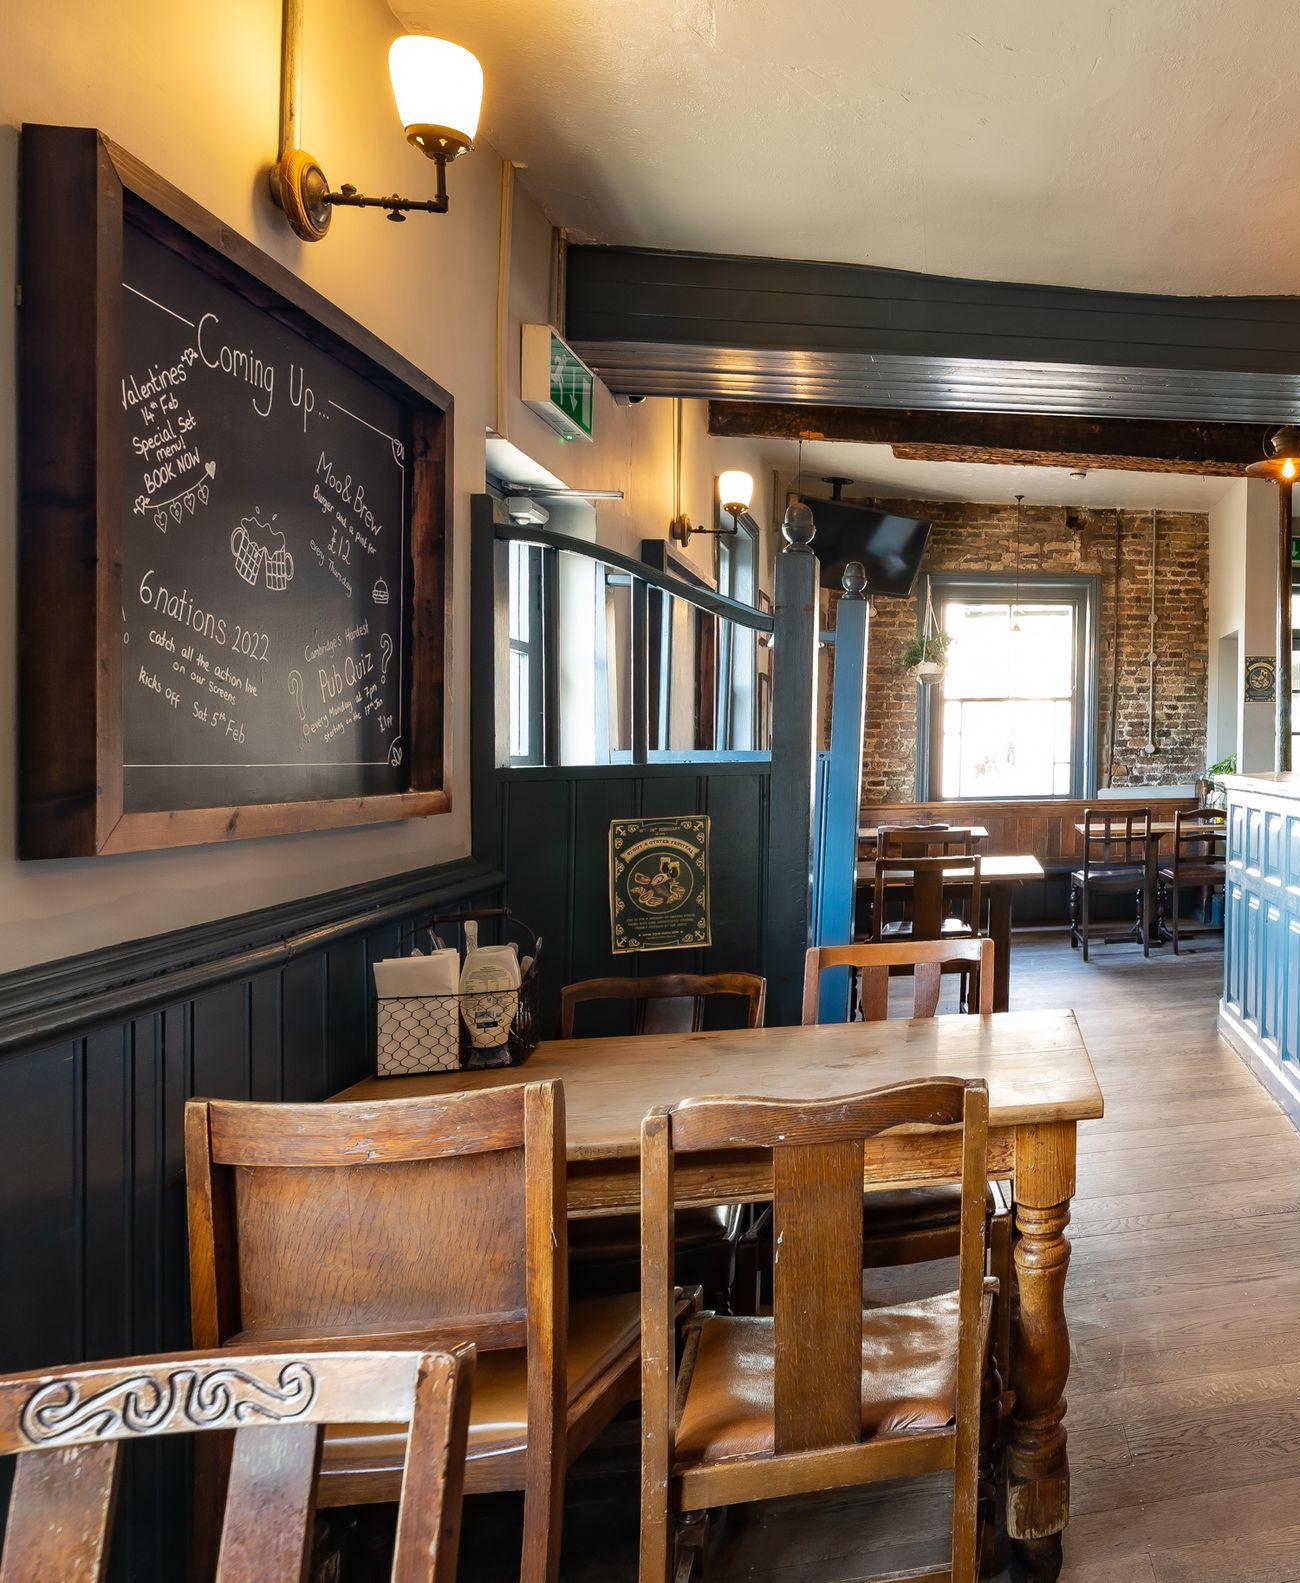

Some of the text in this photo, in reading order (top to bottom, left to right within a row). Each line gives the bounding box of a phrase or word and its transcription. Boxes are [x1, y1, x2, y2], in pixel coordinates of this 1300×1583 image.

[121, 363, 187, 411] Valentines
[198, 312, 274, 417] Coming
[160, 392, 179, 415] Feb
[132, 409, 197, 461] Special Set
[143, 446, 201, 494] BOOK NOW
[313, 484, 334, 514] Burger
[342, 475, 351, 503] &
[354, 485, 382, 536] Brew
[328, 526, 351, 566] £12
[139, 570, 269, 663] 6 nations 2022
[172, 660, 237, 706] on our screens
[181, 645, 194, 662] all
[196, 652, 210, 672] the
[214, 666, 243, 690] action
[245, 677, 259, 698] live
[318, 652, 375, 704] Pub Quiz
[226, 719, 246, 745] Feb
